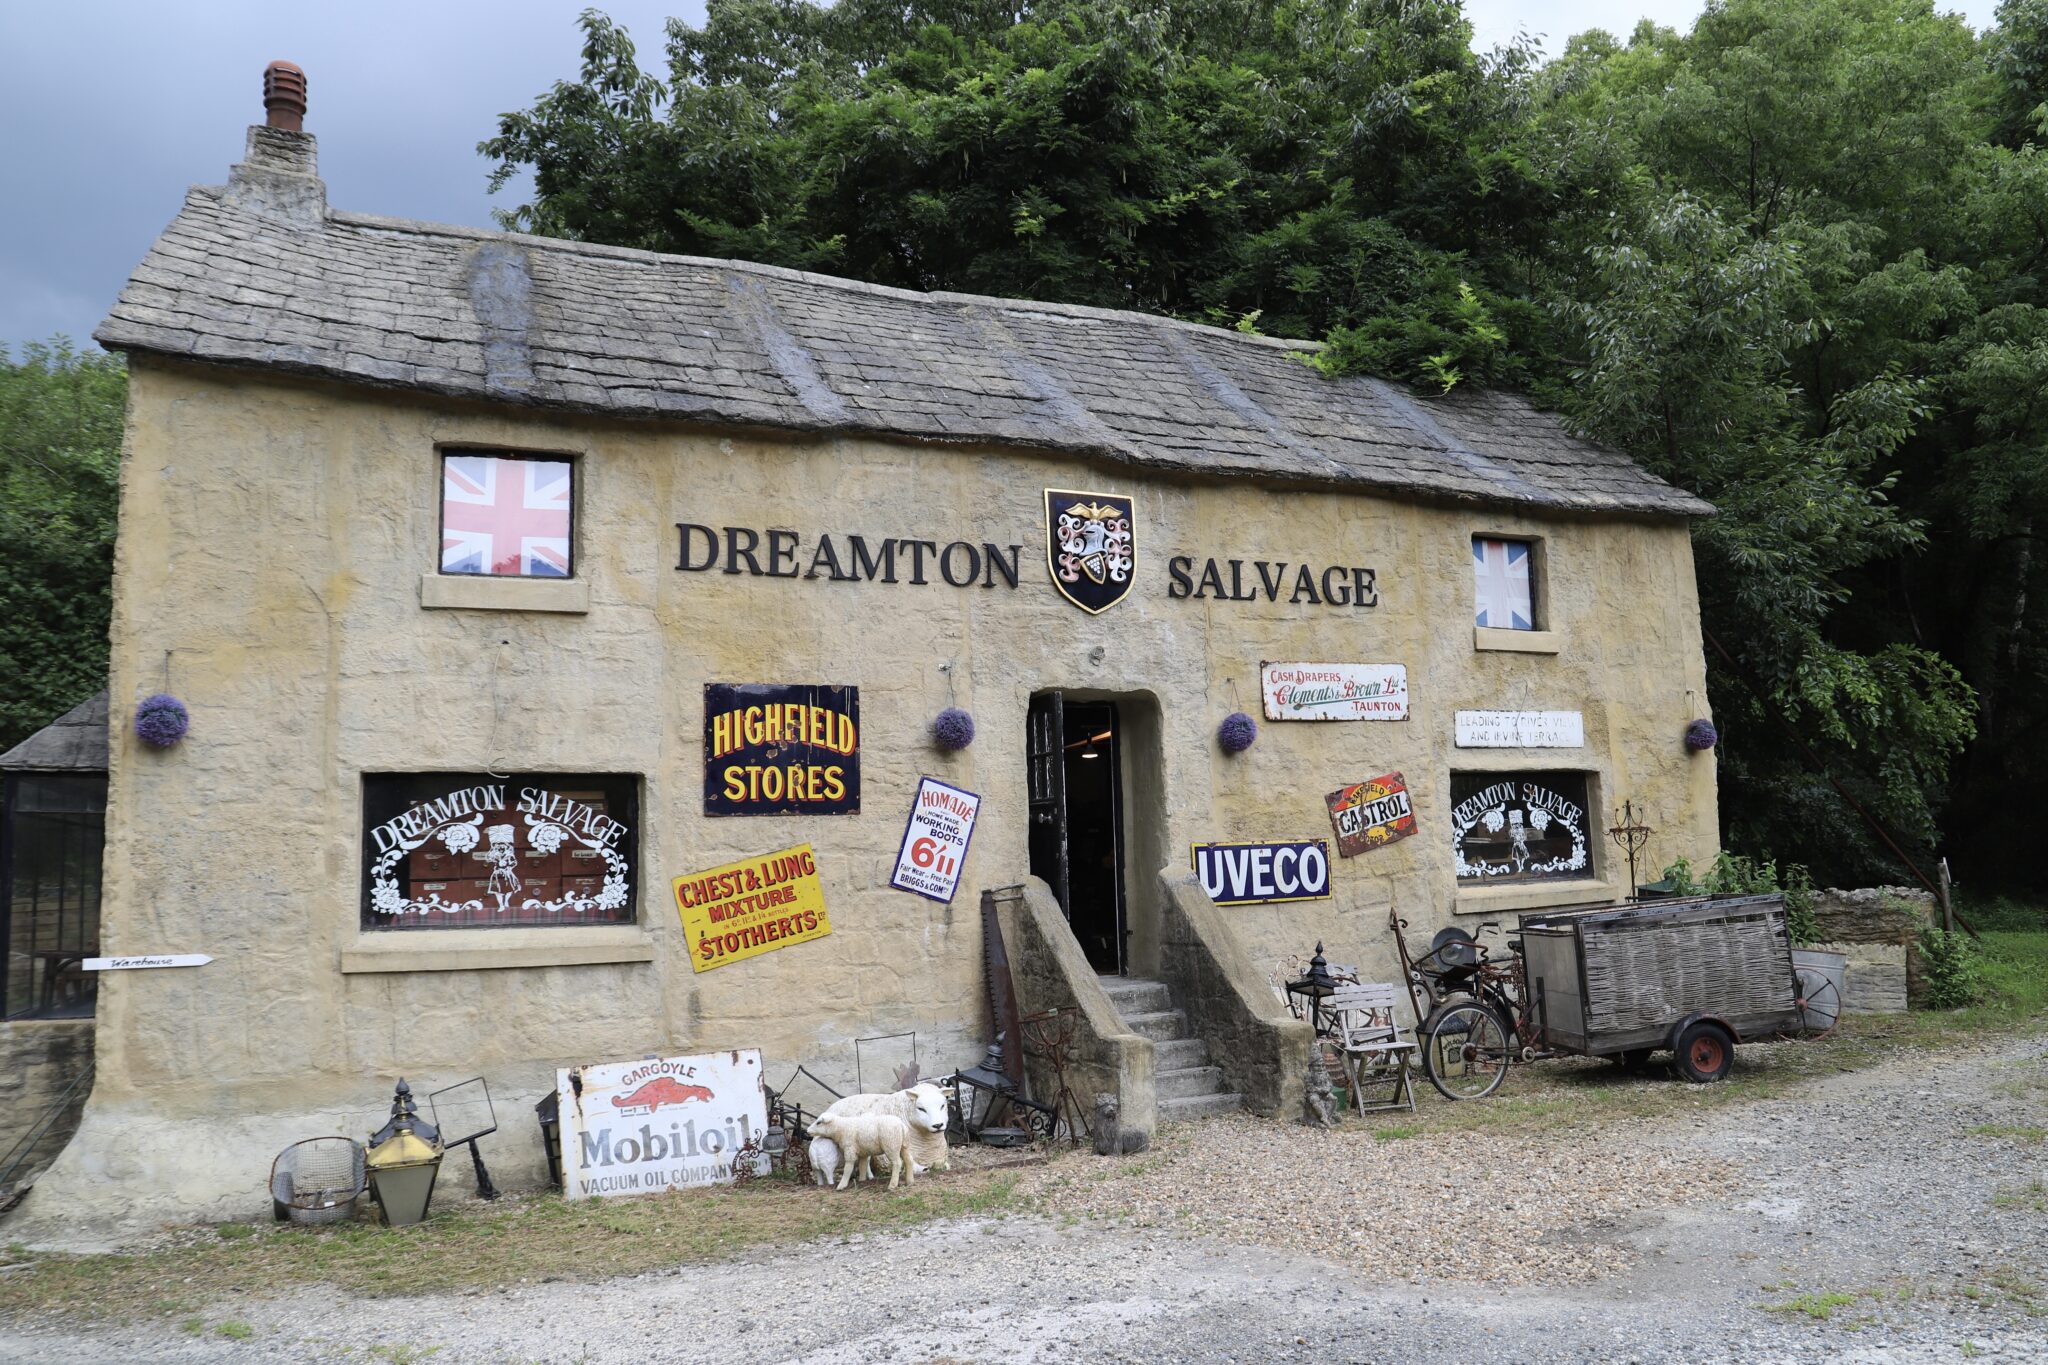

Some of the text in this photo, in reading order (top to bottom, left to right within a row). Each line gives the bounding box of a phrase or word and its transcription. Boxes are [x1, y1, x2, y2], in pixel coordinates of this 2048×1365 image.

[675, 523, 1378, 607] DREAMTON SALVAGE
[1270, 670, 1341, 685] CASH DRAPERS
[1273, 685, 1334, 705] Clements
[1344, 680, 1381, 698] Brown
[1353, 701, 1401, 712] TAUNTON
[1460, 716, 1501, 727] LEADING
[1505, 716, 1517, 727] TO
[713, 703, 856, 759] HIGHFIELD
[1471, 731, 1489, 741] AND
[723, 765, 847, 802] STORES
[371, 785, 628, 854] DREAMTON SALVAGE
[922, 791, 974, 822] HOMADE
[1339, 795, 1408, 834] CASTROL
[1522, 783, 1583, 825] SALVAGE
[916, 814, 959, 835] WORKING
[930, 828, 964, 846] BOOTS
[678, 851, 816, 908] CHEST & LUNG
[900, 863, 911, 872] Fair
[912, 867, 925, 877] Wear
[930, 873, 942, 883] Free
[943, 877, 954, 886] Pair
[900, 873, 925, 888] BRIGGS
[1198, 846, 1327, 899] UVECO
[708, 885, 798, 924] MIXTURE
[698, 910, 818, 960] STOTHERTS
[110, 957, 174, 968] Warehouse
[622, 1062, 697, 1086] GARGOYLE
[578, 1113, 750, 1170] Mobiloil
[580, 1173, 639, 1195] VACUUM
[644, 1171, 668, 1187] OIL
[671, 1162, 736, 1184] COMPANY
